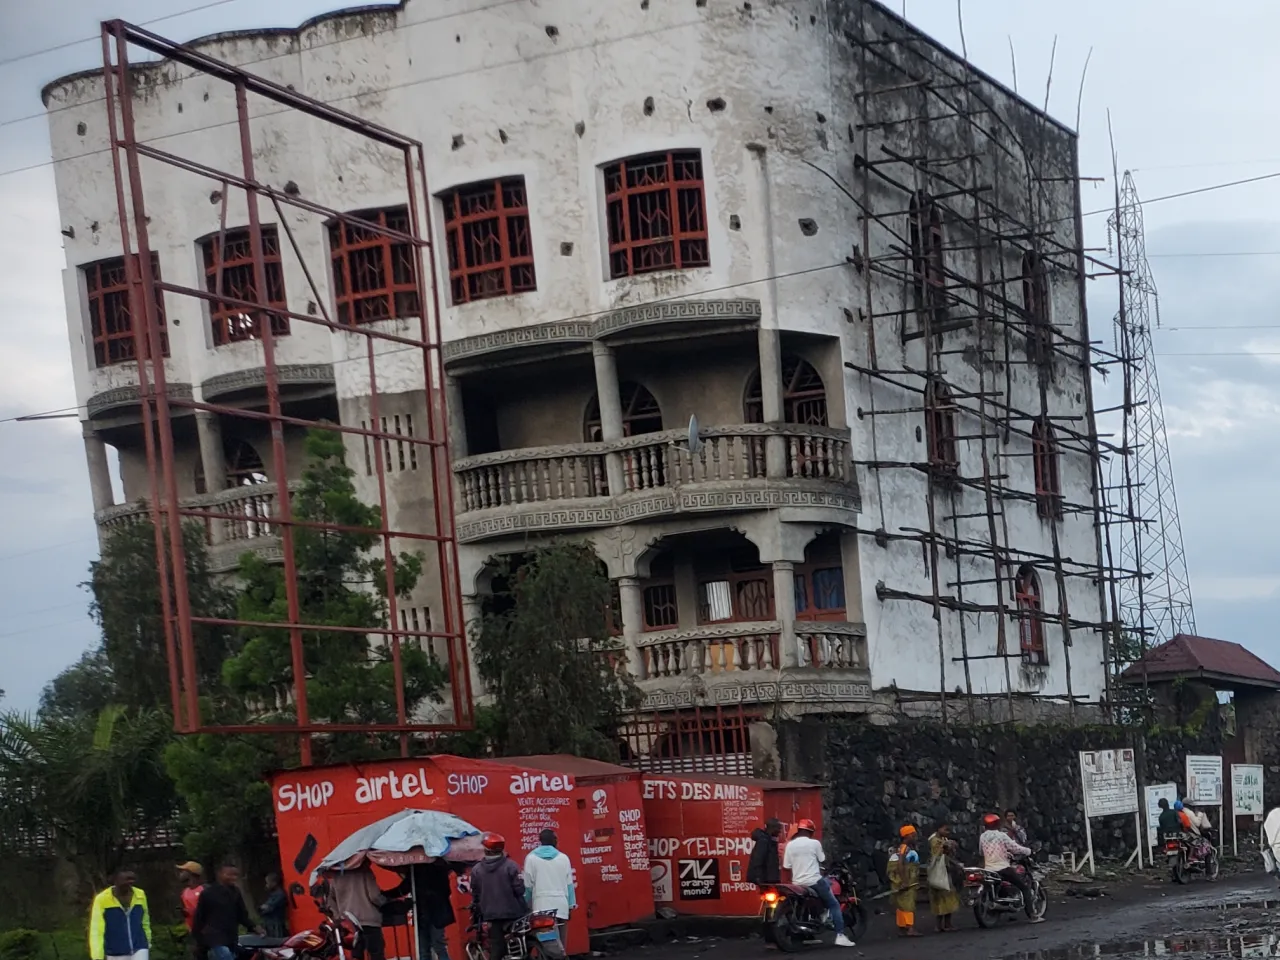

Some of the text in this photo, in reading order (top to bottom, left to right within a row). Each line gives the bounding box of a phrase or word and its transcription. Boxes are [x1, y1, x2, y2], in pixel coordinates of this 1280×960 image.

[355, 768, 433, 804] airtel
[447, 774, 488, 795] SHOP
[509, 772, 574, 795] airtel
[643, 780, 748, 800] ETS DES AMIS
[277, 781, 334, 812] SHOP
[619, 809, 641, 822] SHOP
[647, 838, 680, 856] HOP
[681, 880, 715, 888] orange
